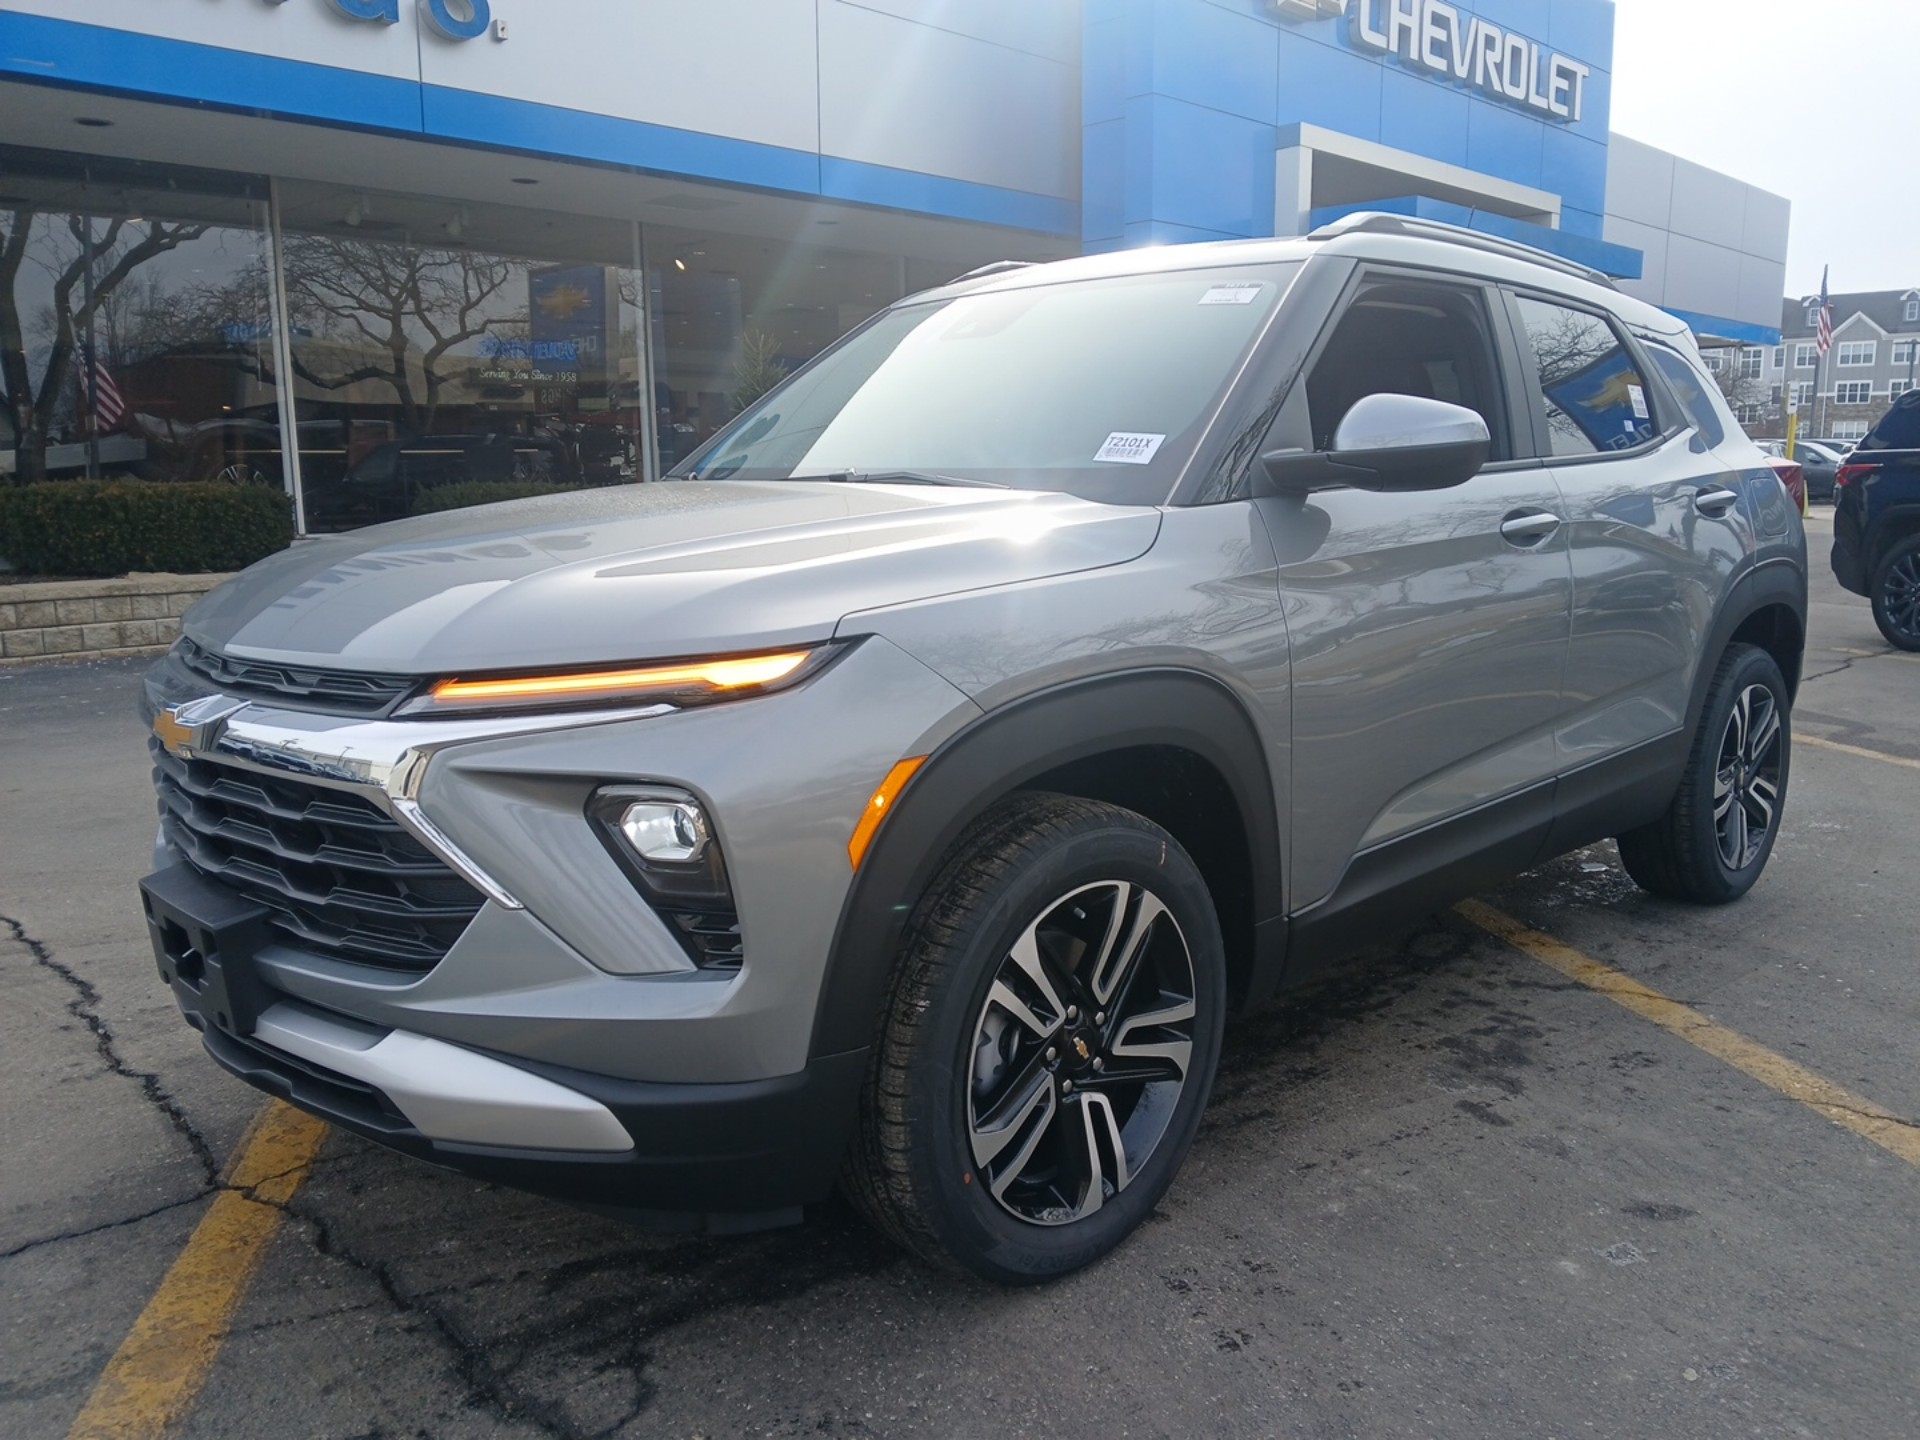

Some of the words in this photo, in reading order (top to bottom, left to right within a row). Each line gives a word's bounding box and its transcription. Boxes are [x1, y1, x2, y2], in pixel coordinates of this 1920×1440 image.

[1360, 0, 1590, 121] CHEVROLET
[479, 367, 510, 382] Serving
[513, 368, 529, 380] You
[531, 368, 553, 380] Since
[555, 371, 577, 382] 1958
[1107, 436, 1154, 449] T2101X
